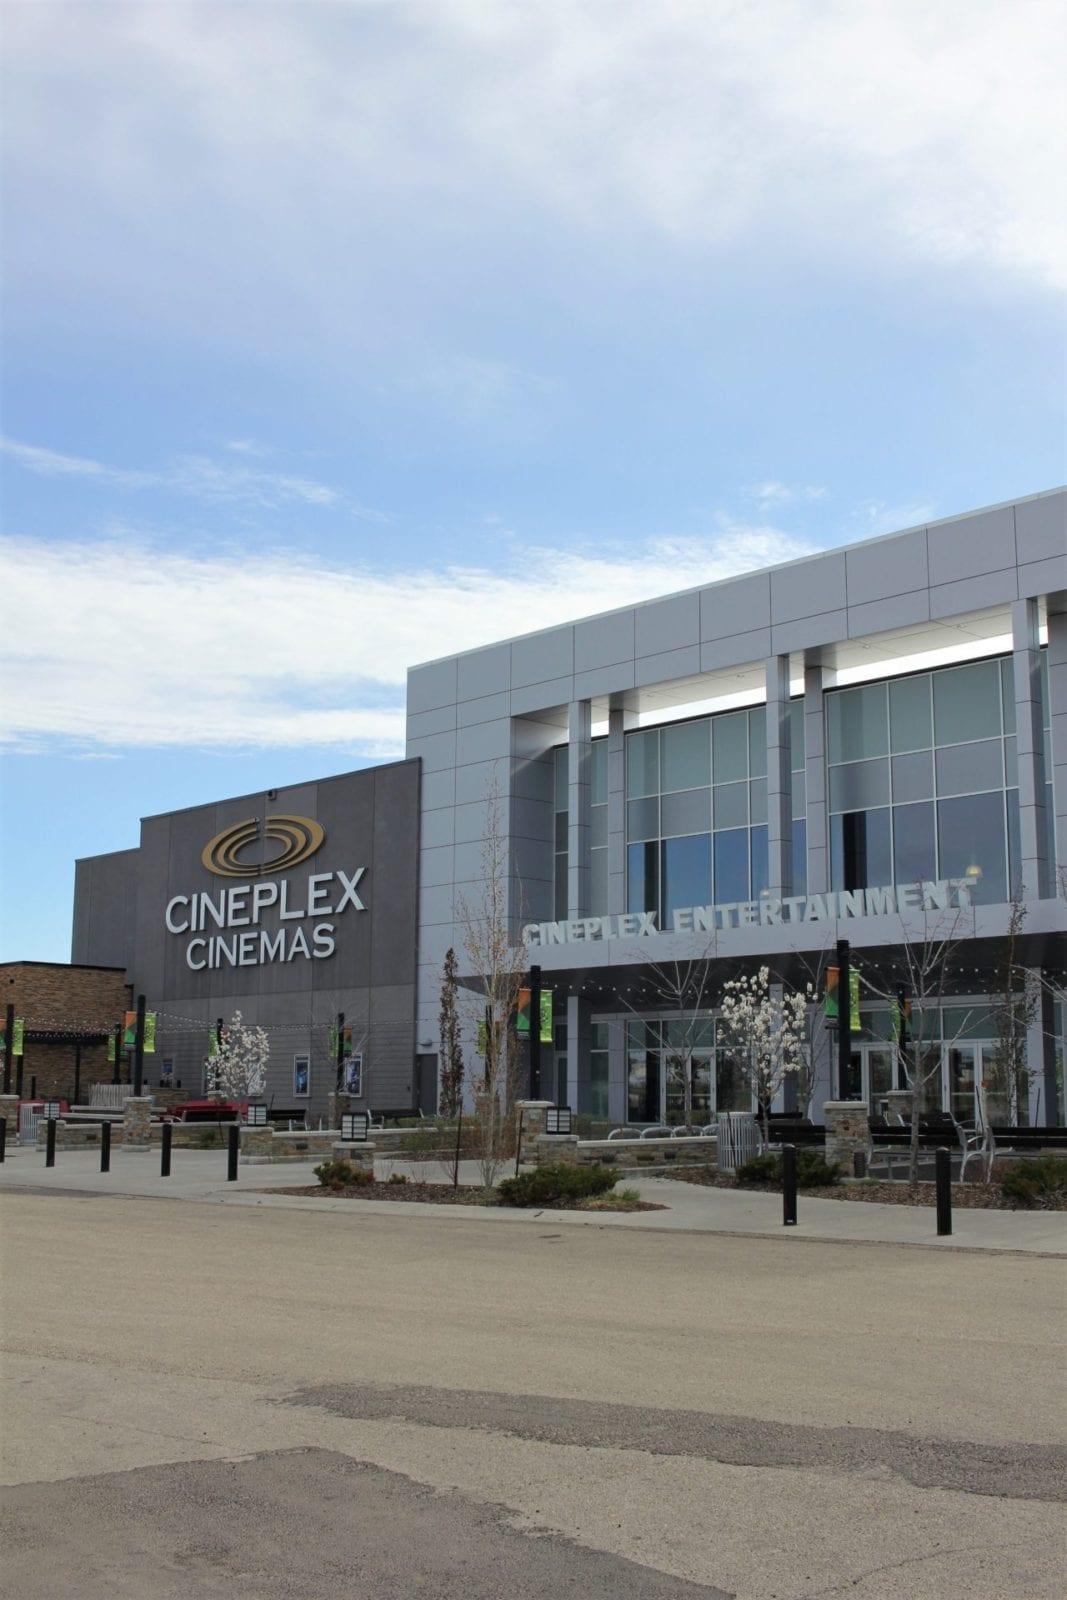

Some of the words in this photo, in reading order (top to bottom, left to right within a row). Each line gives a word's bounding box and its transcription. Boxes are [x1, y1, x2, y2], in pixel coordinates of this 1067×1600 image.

[165, 867, 366, 934] CINEPLEX
[521, 910, 659, 946] CINEPLEX
[672, 877, 977, 933] ENTERTAINMENT
[186, 923, 336, 970] CINEMAS
